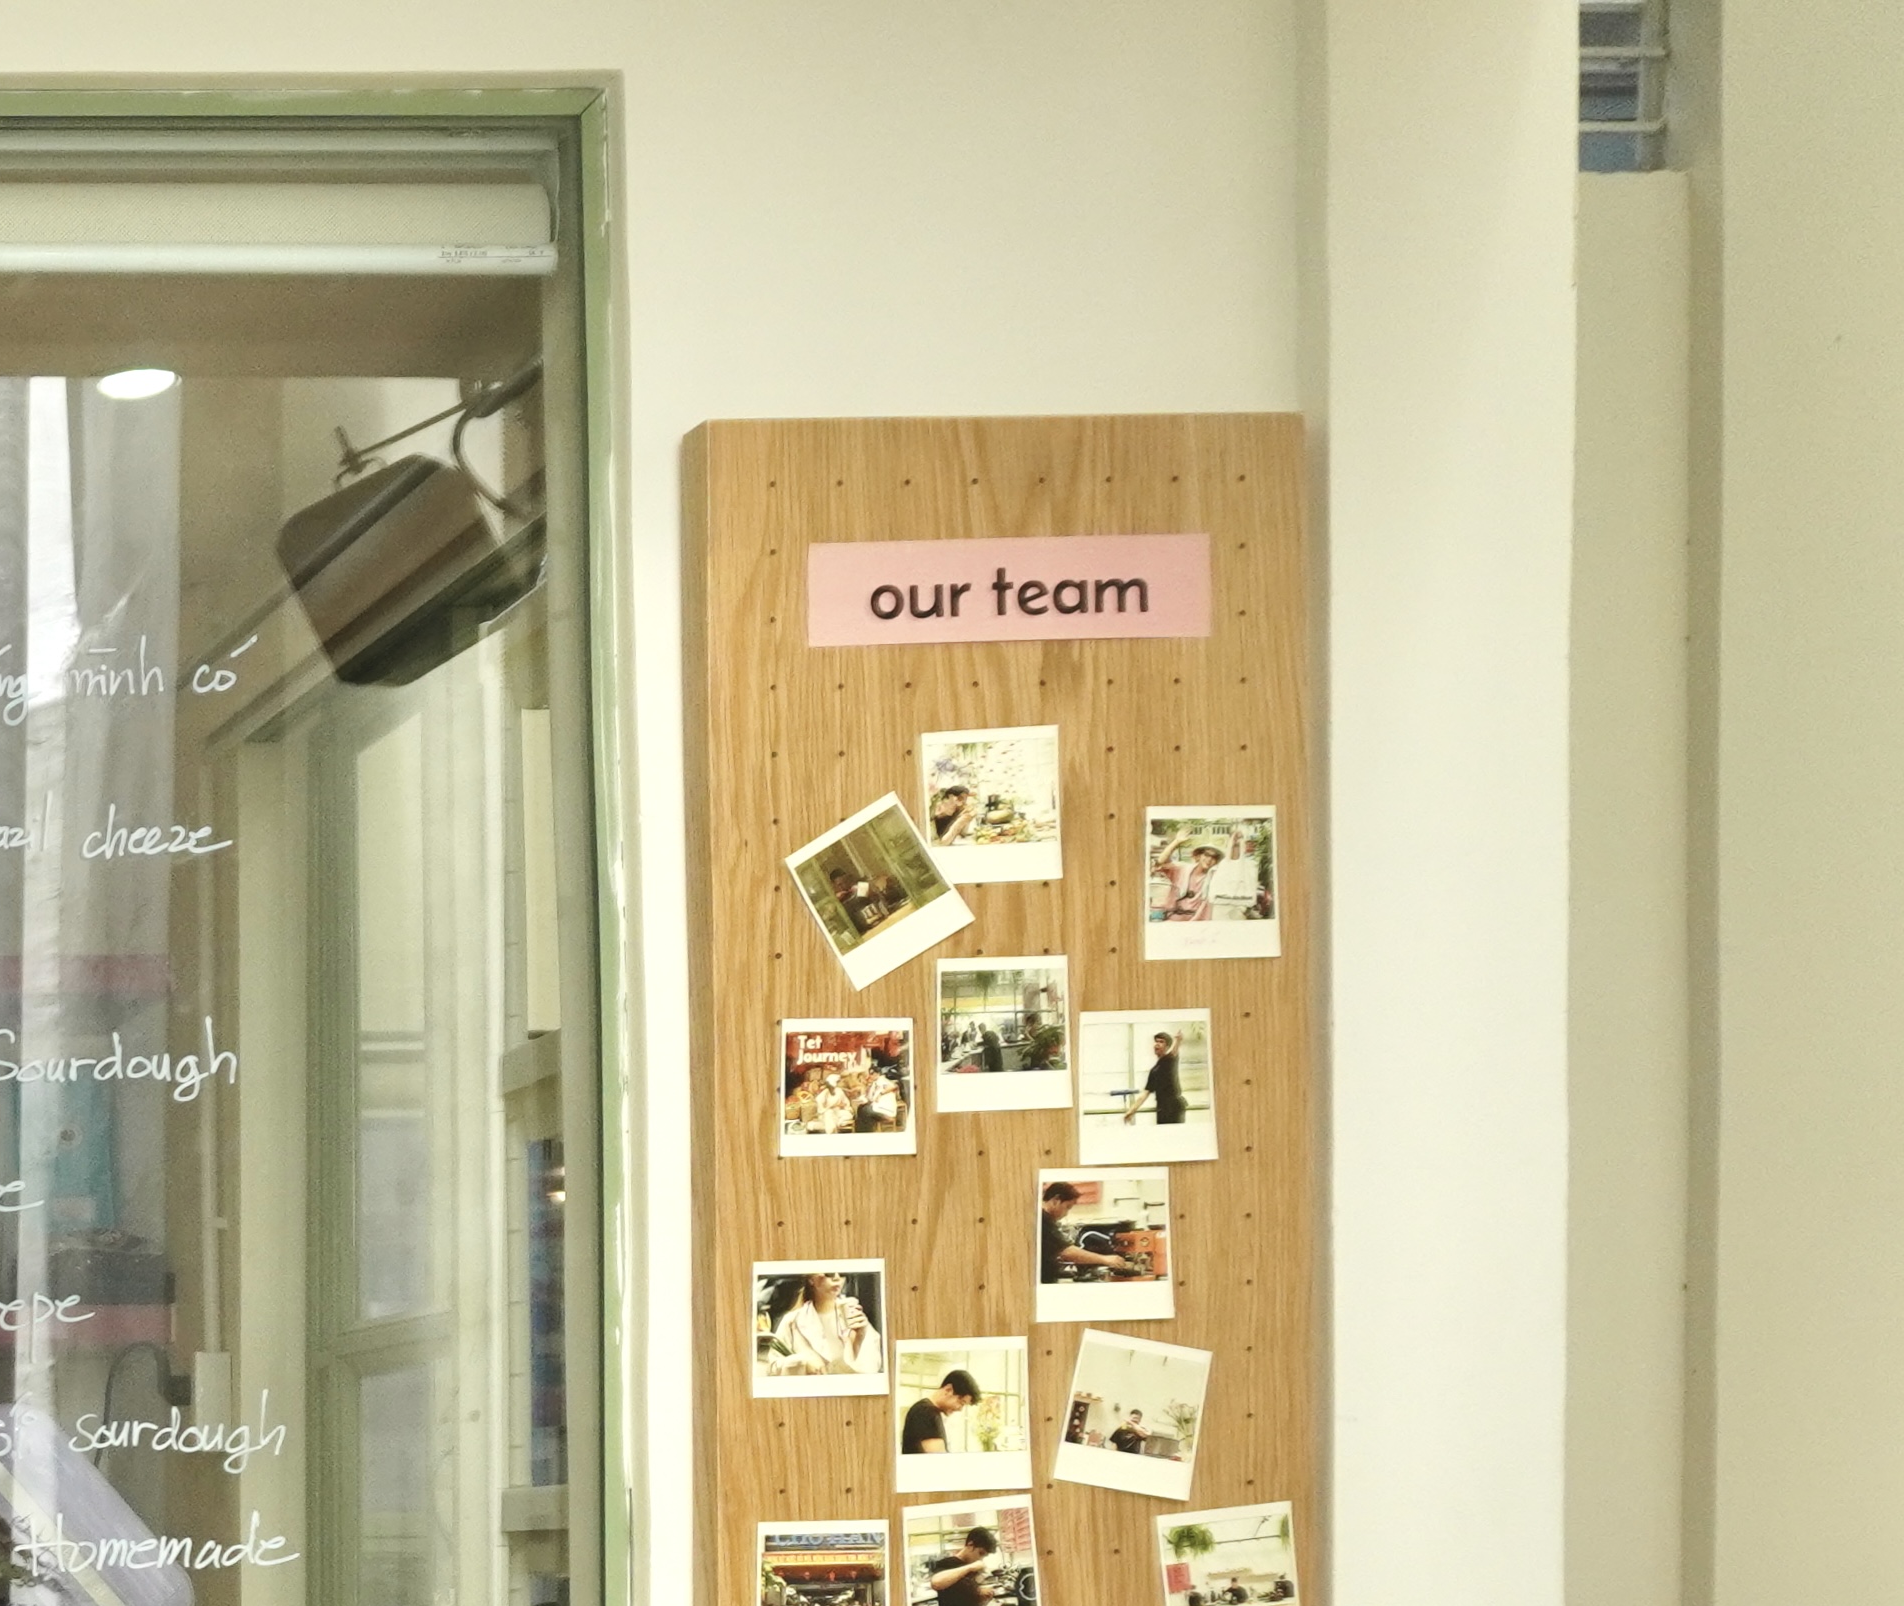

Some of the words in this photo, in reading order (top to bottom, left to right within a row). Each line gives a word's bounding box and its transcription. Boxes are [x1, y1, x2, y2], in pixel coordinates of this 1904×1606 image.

[869, 581, 972, 621] our
[991, 568, 1149, 617] team
[191, 634, 259, 697] có
[80, 803, 234, 861] cheeze
[796, 1049, 857, 1066] Journey
[67, 1389, 288, 1474] sourdough
[13, 1511, 300, 1576] Homemade
